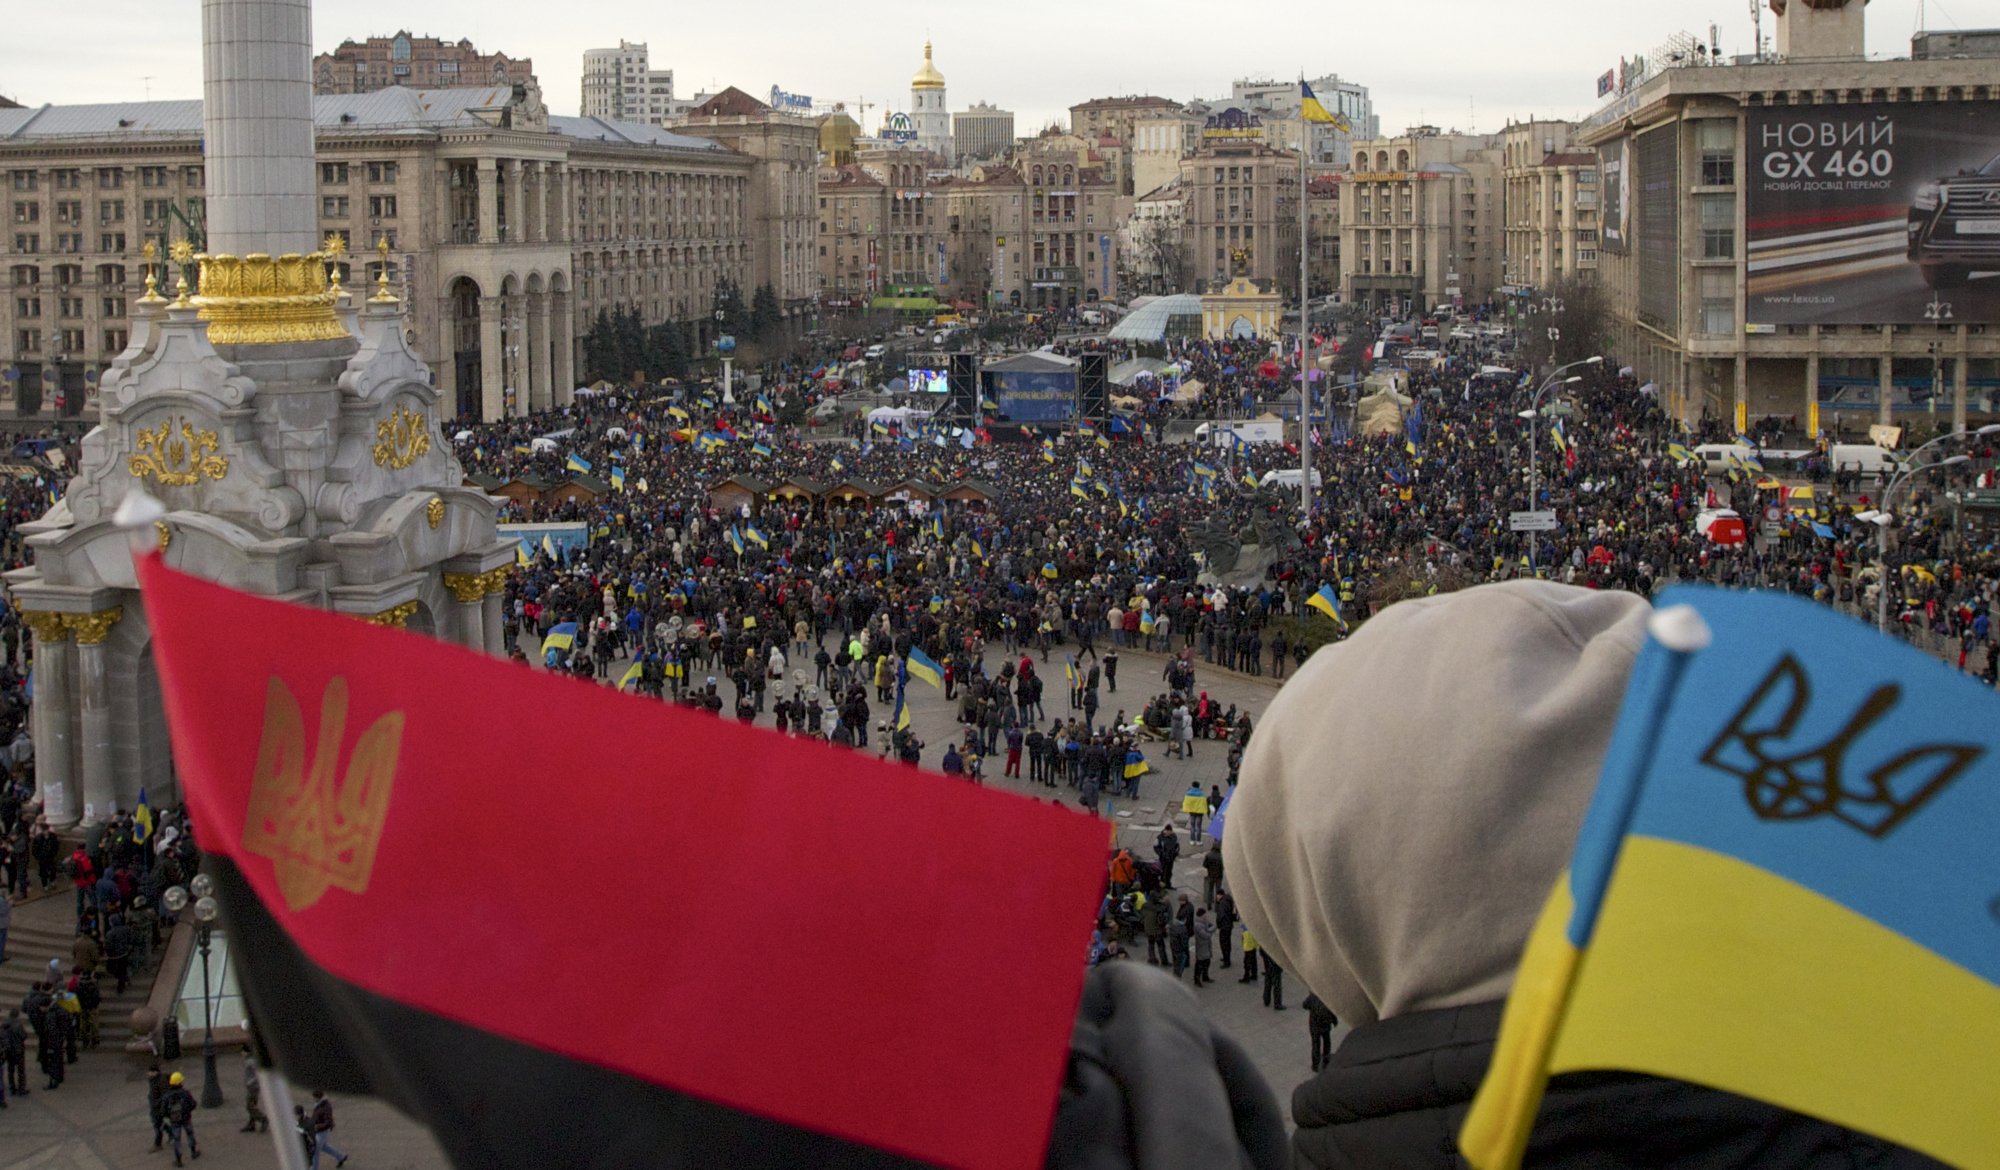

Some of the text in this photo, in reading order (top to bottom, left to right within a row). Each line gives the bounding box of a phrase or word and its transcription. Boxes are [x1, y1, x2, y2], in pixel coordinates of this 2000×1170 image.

[1762, 115, 1894, 148] НОВИЙ
[1763, 149, 1893, 179] GX 460
[1764, 179, 1892, 191] НОВИЙ ДОСВІД ПЕРЕМОГ
[1763, 292, 1835, 304] www.lexus.ua
